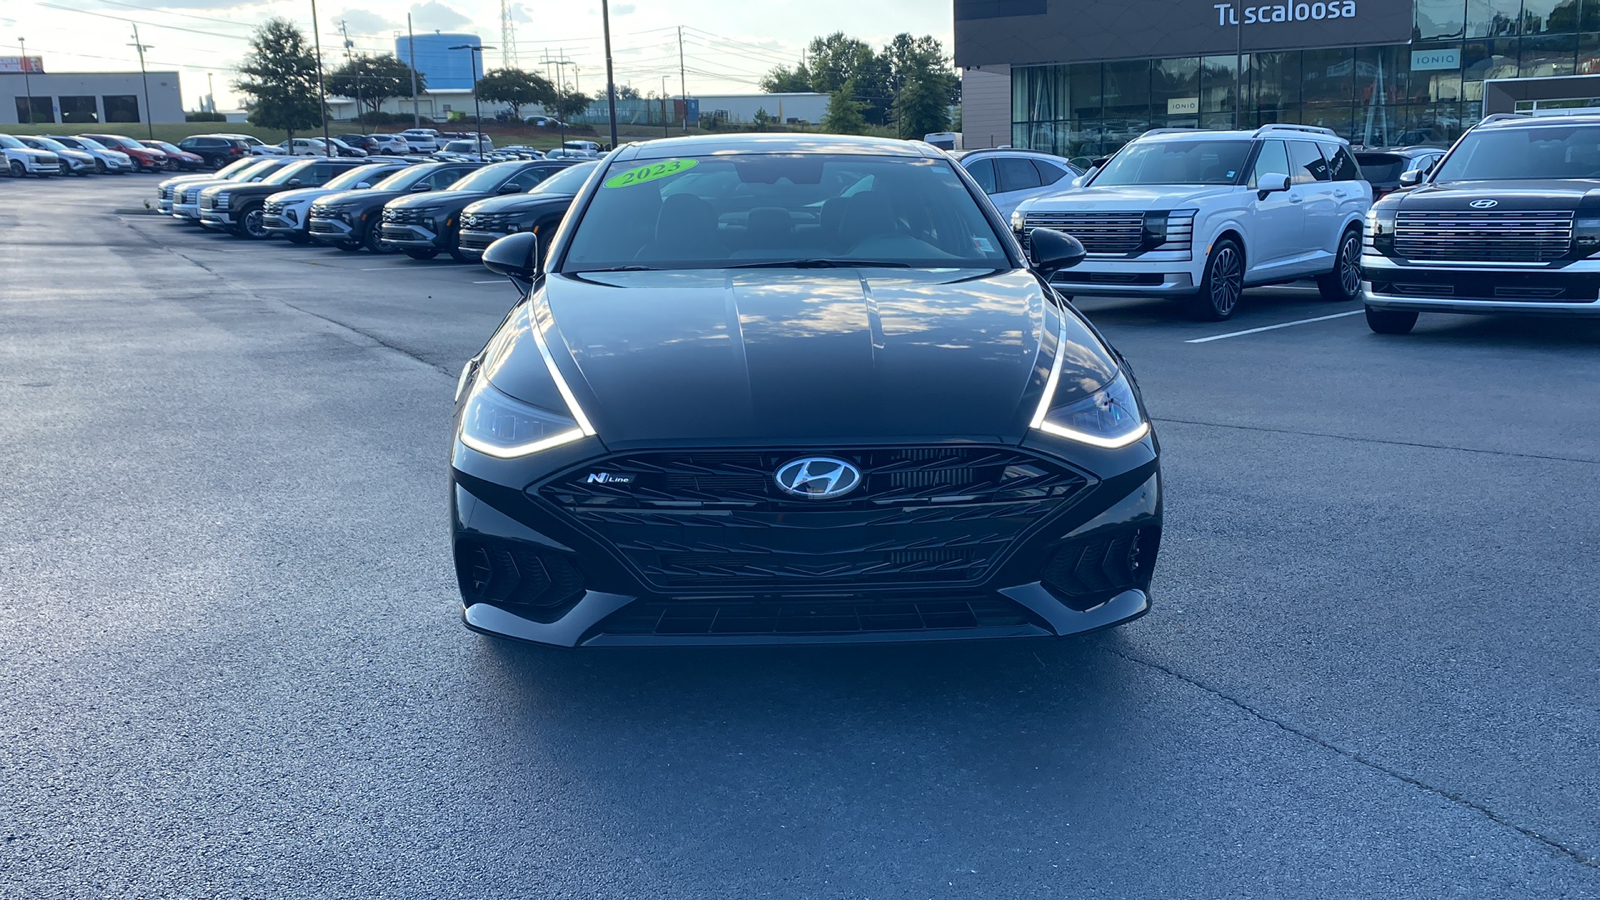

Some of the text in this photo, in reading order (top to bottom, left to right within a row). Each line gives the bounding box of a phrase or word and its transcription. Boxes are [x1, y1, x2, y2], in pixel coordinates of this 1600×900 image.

[1213, 0, 1356, 26] Tuscaloosa
[1416, 55, 1454, 65] IONIQ
[621, 161, 681, 185] 2023
